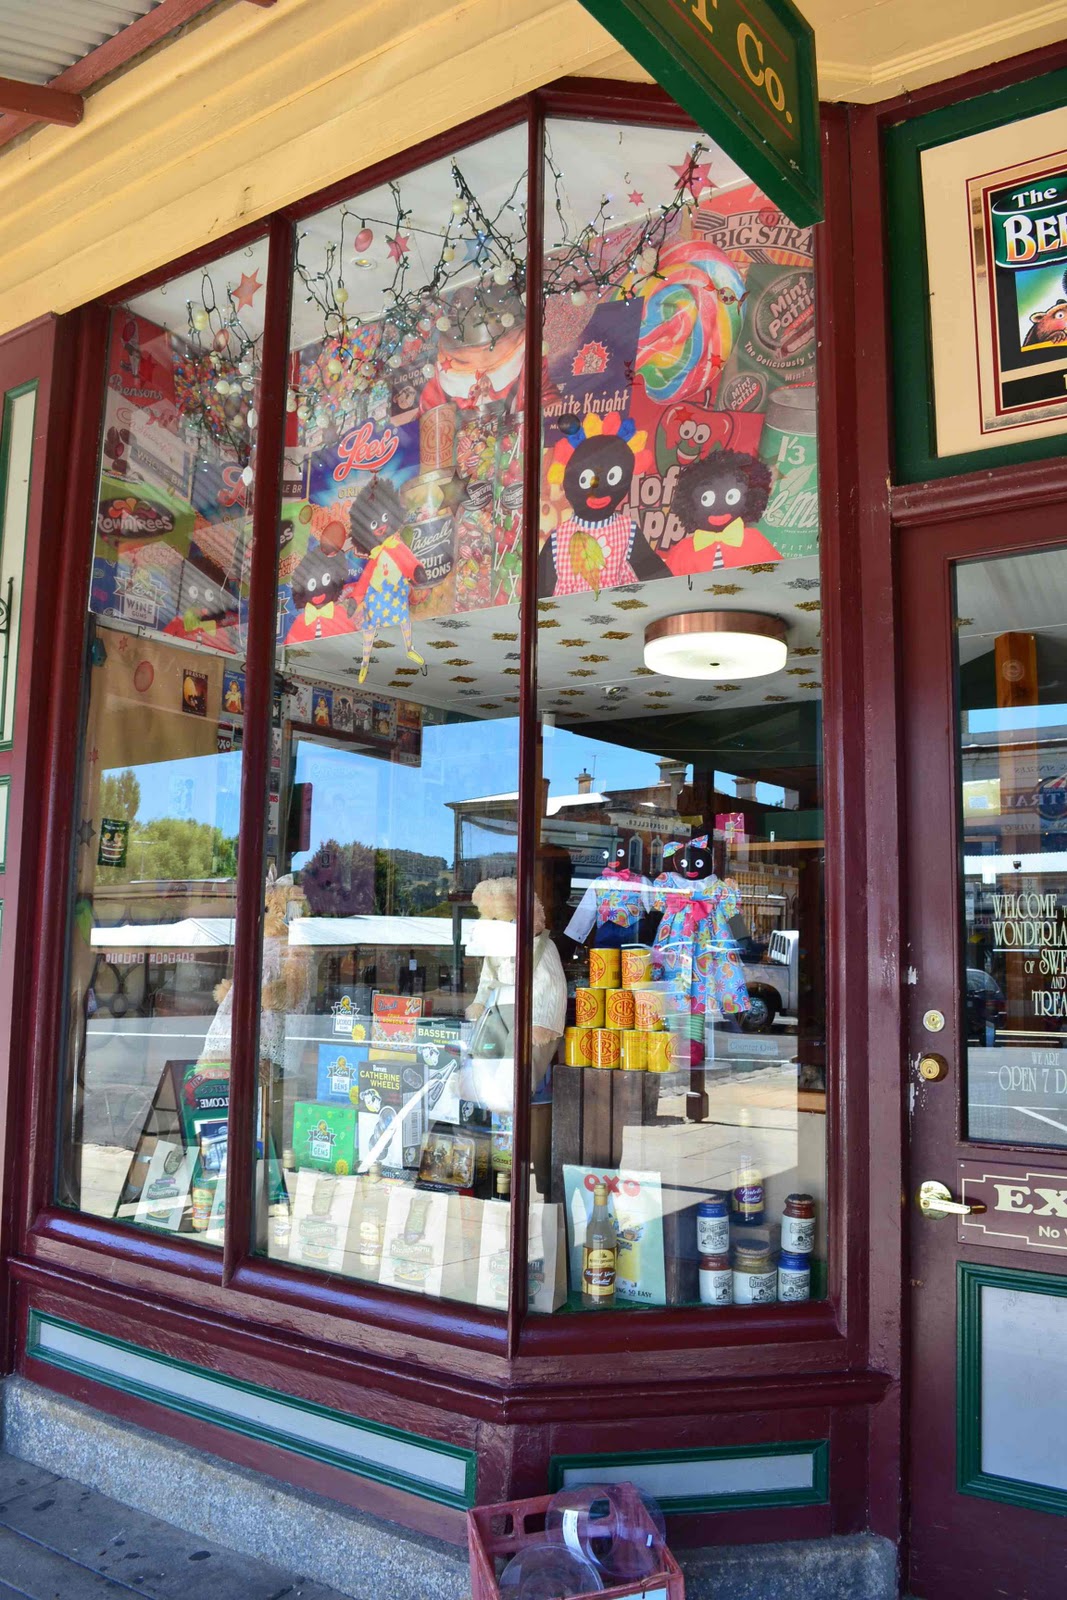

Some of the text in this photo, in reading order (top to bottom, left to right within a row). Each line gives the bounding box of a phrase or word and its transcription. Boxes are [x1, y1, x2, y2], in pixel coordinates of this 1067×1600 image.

[737, 22, 793, 124] Co.
[1011, 187, 1058, 208] The
[711, 226, 813, 254] BIG STRA
[770, 276, 808, 318] Mint
[744, 341, 755, 358] The
[756, 353, 805, 369] Deliciously
[109, 373, 164, 401] Bensons
[732, 376, 752, 399] Mint
[583, 389, 630, 418] Knight
[628, 465, 682, 509] Tof
[622, 503, 688, 550] App
[421, 553, 444, 569] RUIT
[425, 562, 452, 580] BONS
[126, 597, 154, 616] WINE
[991, 893, 1058, 919] WELCOME
[992, 920, 1067, 947] WONDERLA
[1024, 948, 1067, 975] OF SWE
[1050, 976, 1067, 990] AND
[1031, 989, 1067, 1017] TREA
[418, 1028, 460, 1040] BASSETTI
[1031, 1051, 1060, 1066] WE ARE
[359, 1070, 401, 1083] CATHERINE
[369, 1079, 401, 1091] WHEELS
[998, 1065, 1038, 1093] OPEN
[1042, 1068, 1050, 1093] 7
[584, 1173, 641, 1198] OXO
[993, 1183, 1067, 1219] EX
[1038, 1225, 1061, 1239] No
[637, 1290, 653, 1298] EASY
